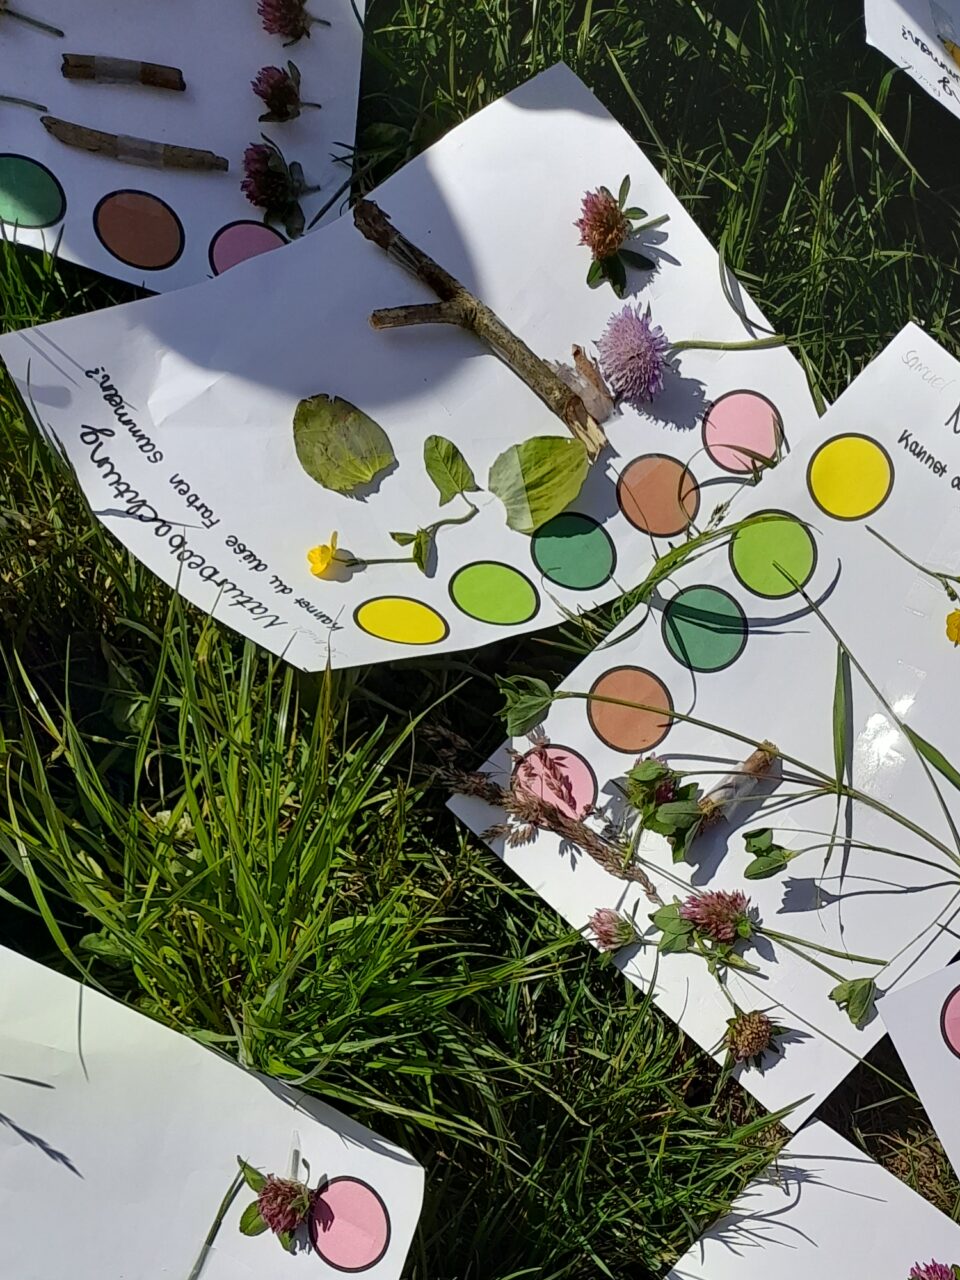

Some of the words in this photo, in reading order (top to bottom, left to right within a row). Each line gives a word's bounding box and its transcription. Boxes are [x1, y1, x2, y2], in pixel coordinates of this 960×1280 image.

[897, 429, 948, 478] Kannst
[169, 473, 220, 529] Farben
[80, 424, 288, 629] Naturbeobachtung
[225, 534, 268, 573] diese
[269, 575, 293, 594] du
[294, 597, 344, 632] Kannst
